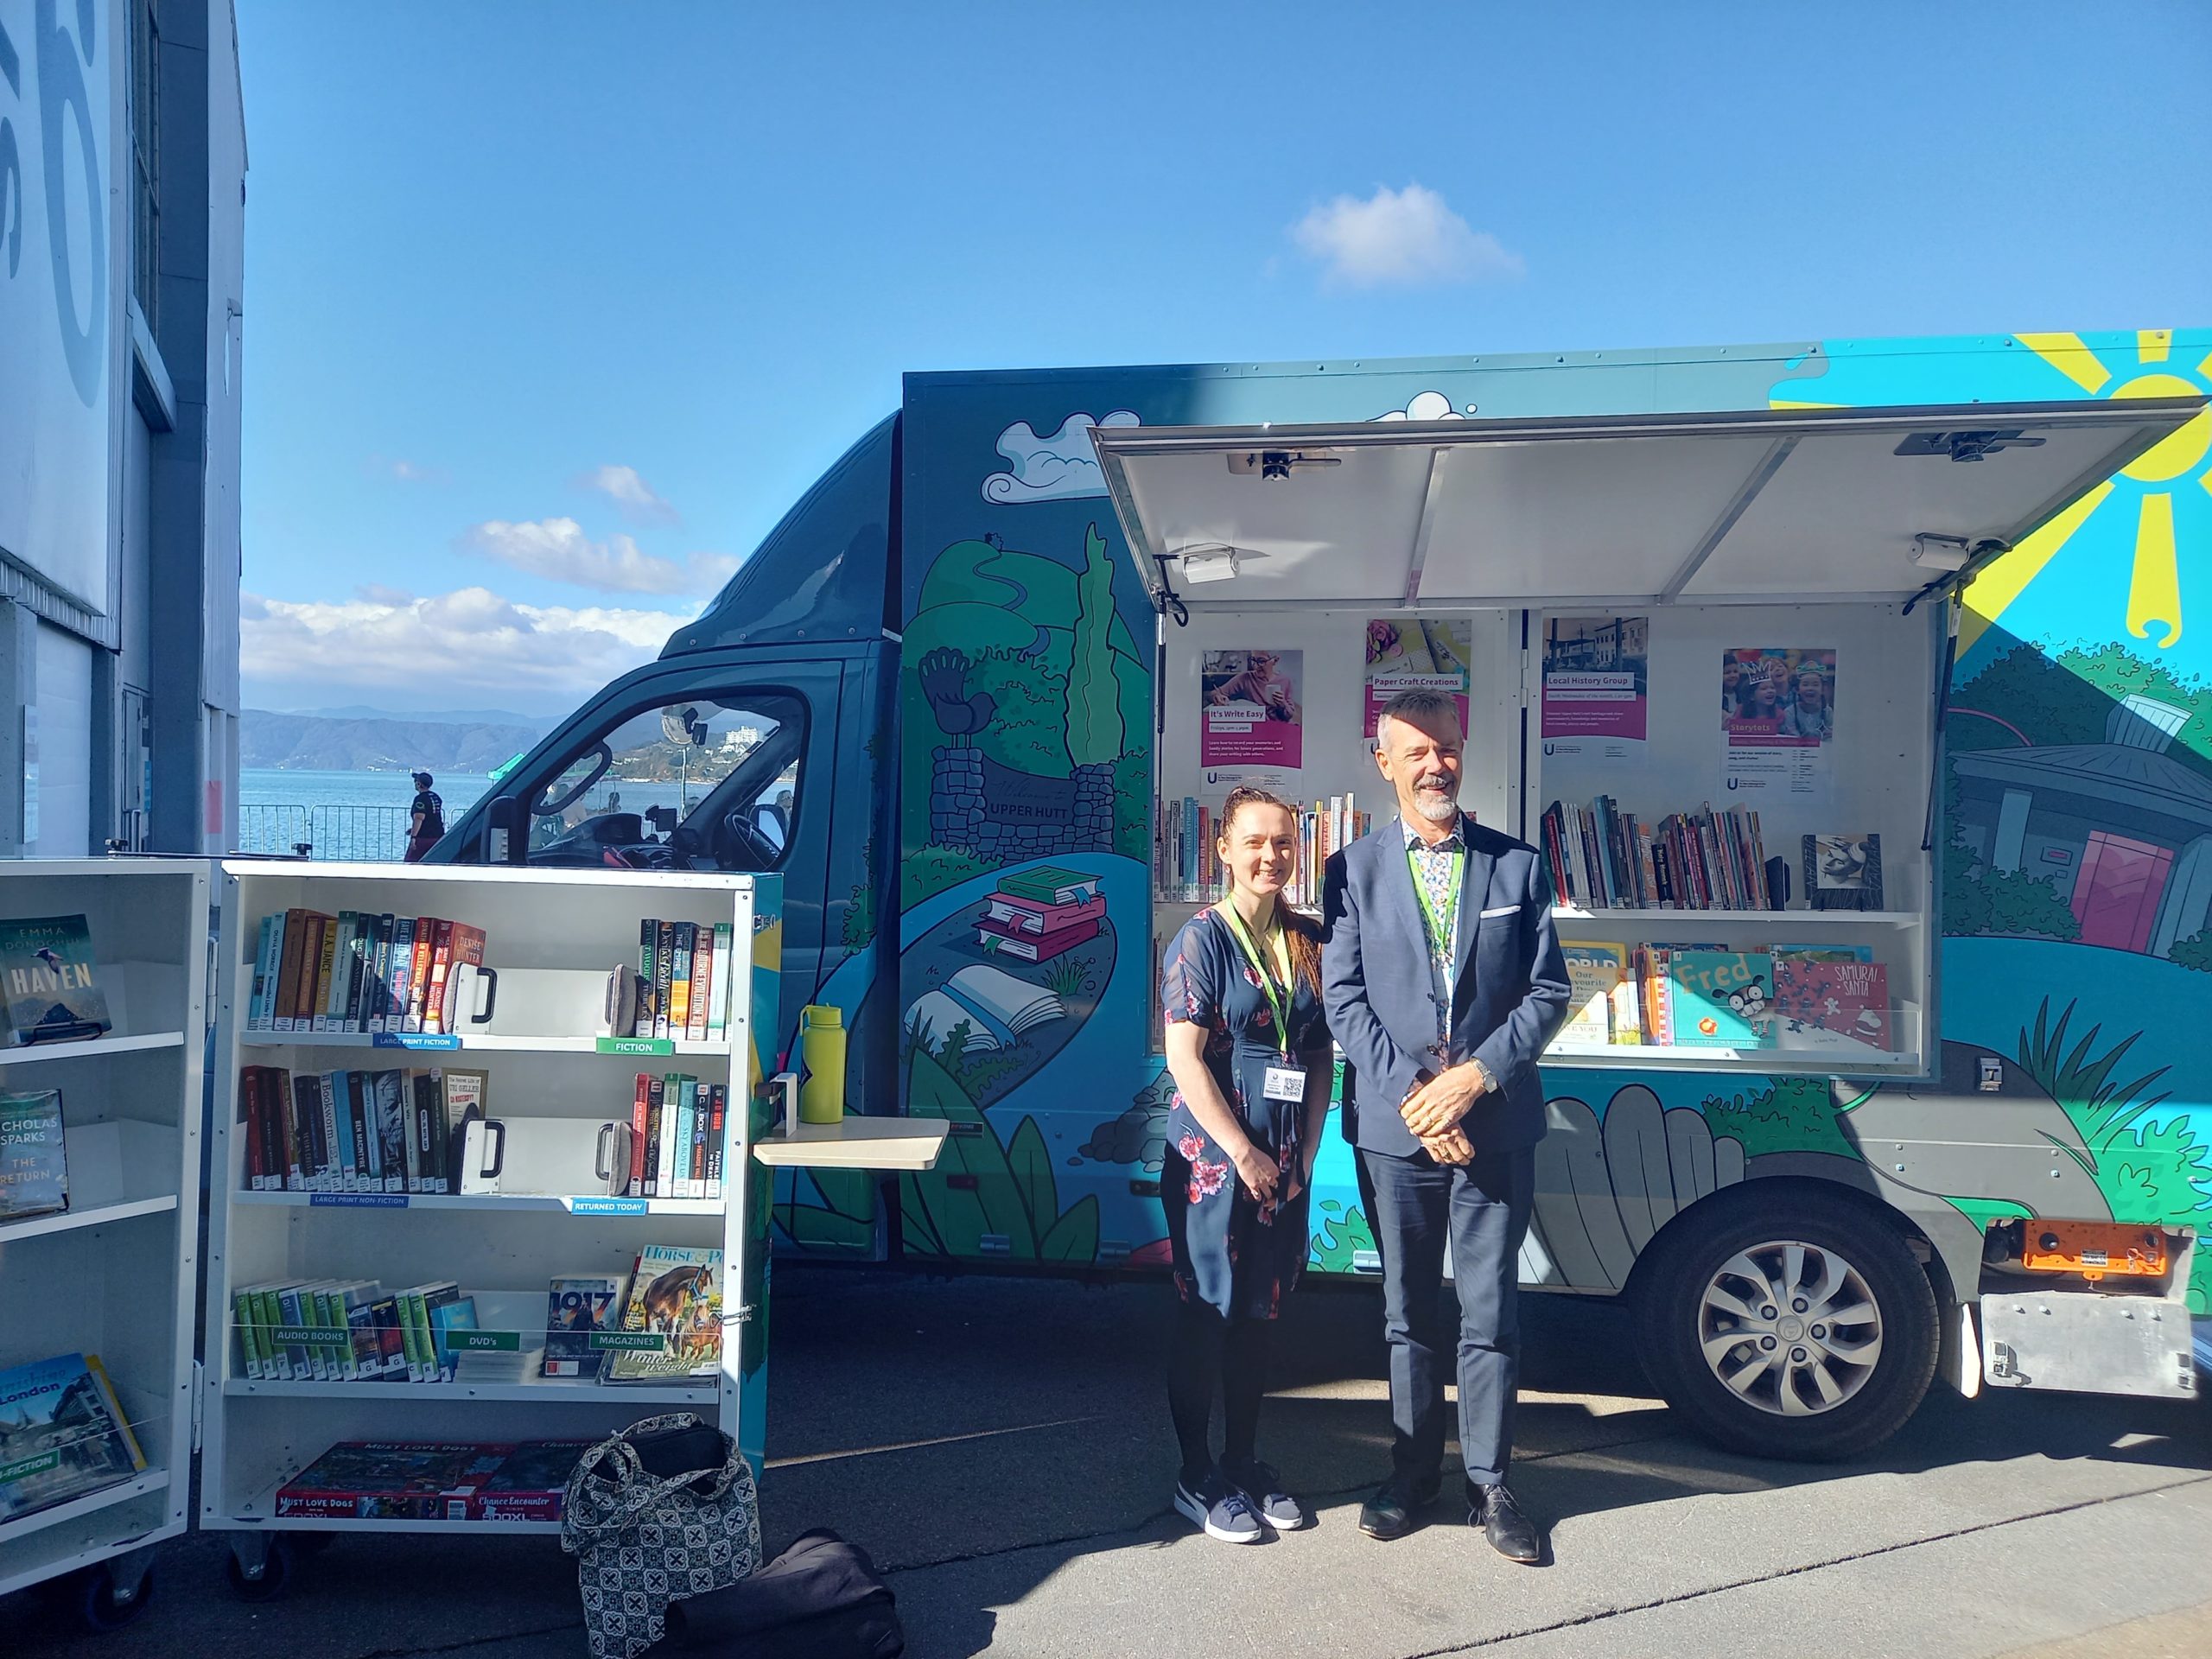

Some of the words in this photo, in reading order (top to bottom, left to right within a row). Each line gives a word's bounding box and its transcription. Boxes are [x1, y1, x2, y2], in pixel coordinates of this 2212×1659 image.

[1399, 677, 1419, 686] Craft
[1246, 710, 1264, 720] Easy
[990, 804, 1033, 817] UPPER
[1036, 805, 1069, 819] HUTT
[19, 926, 66, 938] EMMA
[418, 921, 429, 950] JONATHAN
[460, 937, 481, 950] DENISE
[321, 949, 333, 973] JANCE
[456, 949, 480, 963] HUNTER
[696, 950, 709, 976] BOURNE
[415, 950, 426, 983] KELLERMAN
[1676, 953, 1752, 995] Fred
[1834, 965, 1878, 982] SAMURAI
[10, 963, 92, 995] HAVEN
[692, 977, 707, 1014] EVOLUTION
[1843, 980, 1869, 996] SANTA
[427, 985, 436, 1010] HUNTER
[434, 987, 442, 1008] DENISE
[615, 1042, 653, 1052] FICTION
[321, 1084, 334, 1140] Bookworm
[1, 1117, 57, 1132] CHOLAS
[713, 1112, 722, 1130] ROBB
[0, 1131, 46, 1146] SPARKS
[356, 1134, 365, 1168] MACINTYRE
[12, 1157, 36, 1169] THE
[0, 1169, 50, 1184] RETURN
[645, 1246, 695, 1262] HORSE
[550, 1291, 617, 1325] 1917
[277, 1331, 308, 1340] AUDIO
[311, 1332, 344, 1341] BOOKS
[468, 1337, 497, 1346] DVD's
[599, 1336, 654, 1346] MAGAZINES
[0, 1382, 60, 1405] London
[0, 1456, 53, 1479] -FICTION
[280, 1497, 303, 1507] MUST
[330, 1499, 353, 1508] DOGS
[479, 1497, 509, 1505] Chance
[510, 1497, 550, 1506] Encounter
